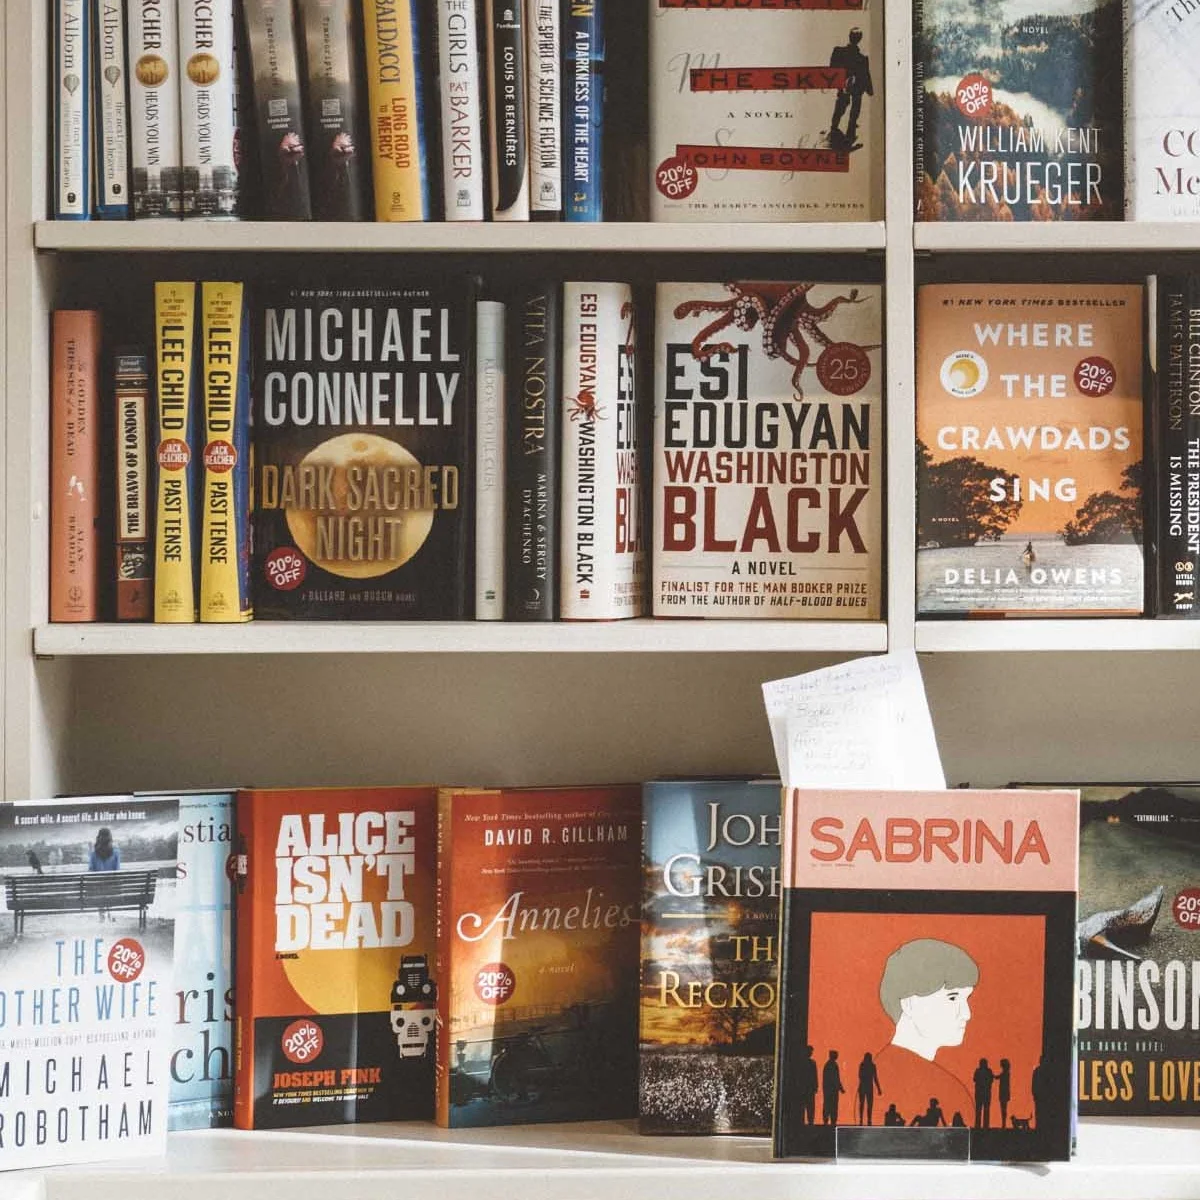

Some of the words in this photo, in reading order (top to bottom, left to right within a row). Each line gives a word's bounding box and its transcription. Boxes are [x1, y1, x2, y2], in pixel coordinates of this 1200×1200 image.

[445, 1, 467, 11] THE
[447, 14, 468, 73] GIRLS
[503, 46, 515, 81] LOUIS
[691, 70, 753, 89] THE
[771, 71, 839, 89] SKY
[450, 81, 468, 92] PAT
[505, 86, 515, 100] DE
[957, 81, 989, 103] 20%
[145, 90, 158, 120] HEADS
[391, 97, 407, 131] LONG
[965, 97, 989, 116] OFF
[146, 121, 159, 144] YOU
[377, 116, 392, 160] MERCY
[450, 95, 472, 179] BARKER
[505, 104, 518, 167] BERNIÈRES
[958, 125, 1044, 153] WILLIAM
[1054, 127, 1101, 155] KENT
[147, 146, 159, 166] WIN
[393, 133, 410, 169] ROAD
[659, 166, 693, 184] 20%
[667, 179, 693, 197] OFF
[958, 162, 1103, 205] KRUEGER
[208, 327, 231, 365] LEE
[265, 308, 460, 362] MICHAEL
[974, 323, 1093, 347] WHERE
[664, 343, 749, 400] ESI
[1000, 375, 1066, 398] THE
[208, 371, 231, 432] CHILD
[263, 372, 460, 426] CONNELLY
[125, 401, 137, 448] LONDON
[664, 402, 870, 450] EDUGYAN
[937, 426, 1130, 450] CRAWDADS
[126, 452, 138, 468] OF
[664, 451, 870, 485] WASHINGTON
[126, 471, 140, 508] BRAVO
[211, 482, 228, 519] PAST
[990, 478, 1077, 502] SING
[127, 512, 140, 534] THE
[662, 486, 870, 554] BLACK
[210, 524, 227, 565] TENSE
[944, 568, 1019, 585] DELIA
[1030, 568, 1122, 585] OWENS
[276, 811, 415, 857] ALICE
[484, 827, 533, 847] DAVID
[541, 827, 556, 845] R.
[562, 825, 628, 845] GILLHAM
[810, 817, 1051, 866] SABRINA
[276, 854, 415, 905] ISN'T
[275, 901, 415, 951] DEAD
[55, 938, 104, 977] THE
[96, 981, 158, 1022] WIFE
[273, 1069, 336, 1088] JOSEPH
[341, 1066, 381, 1085] FINK
